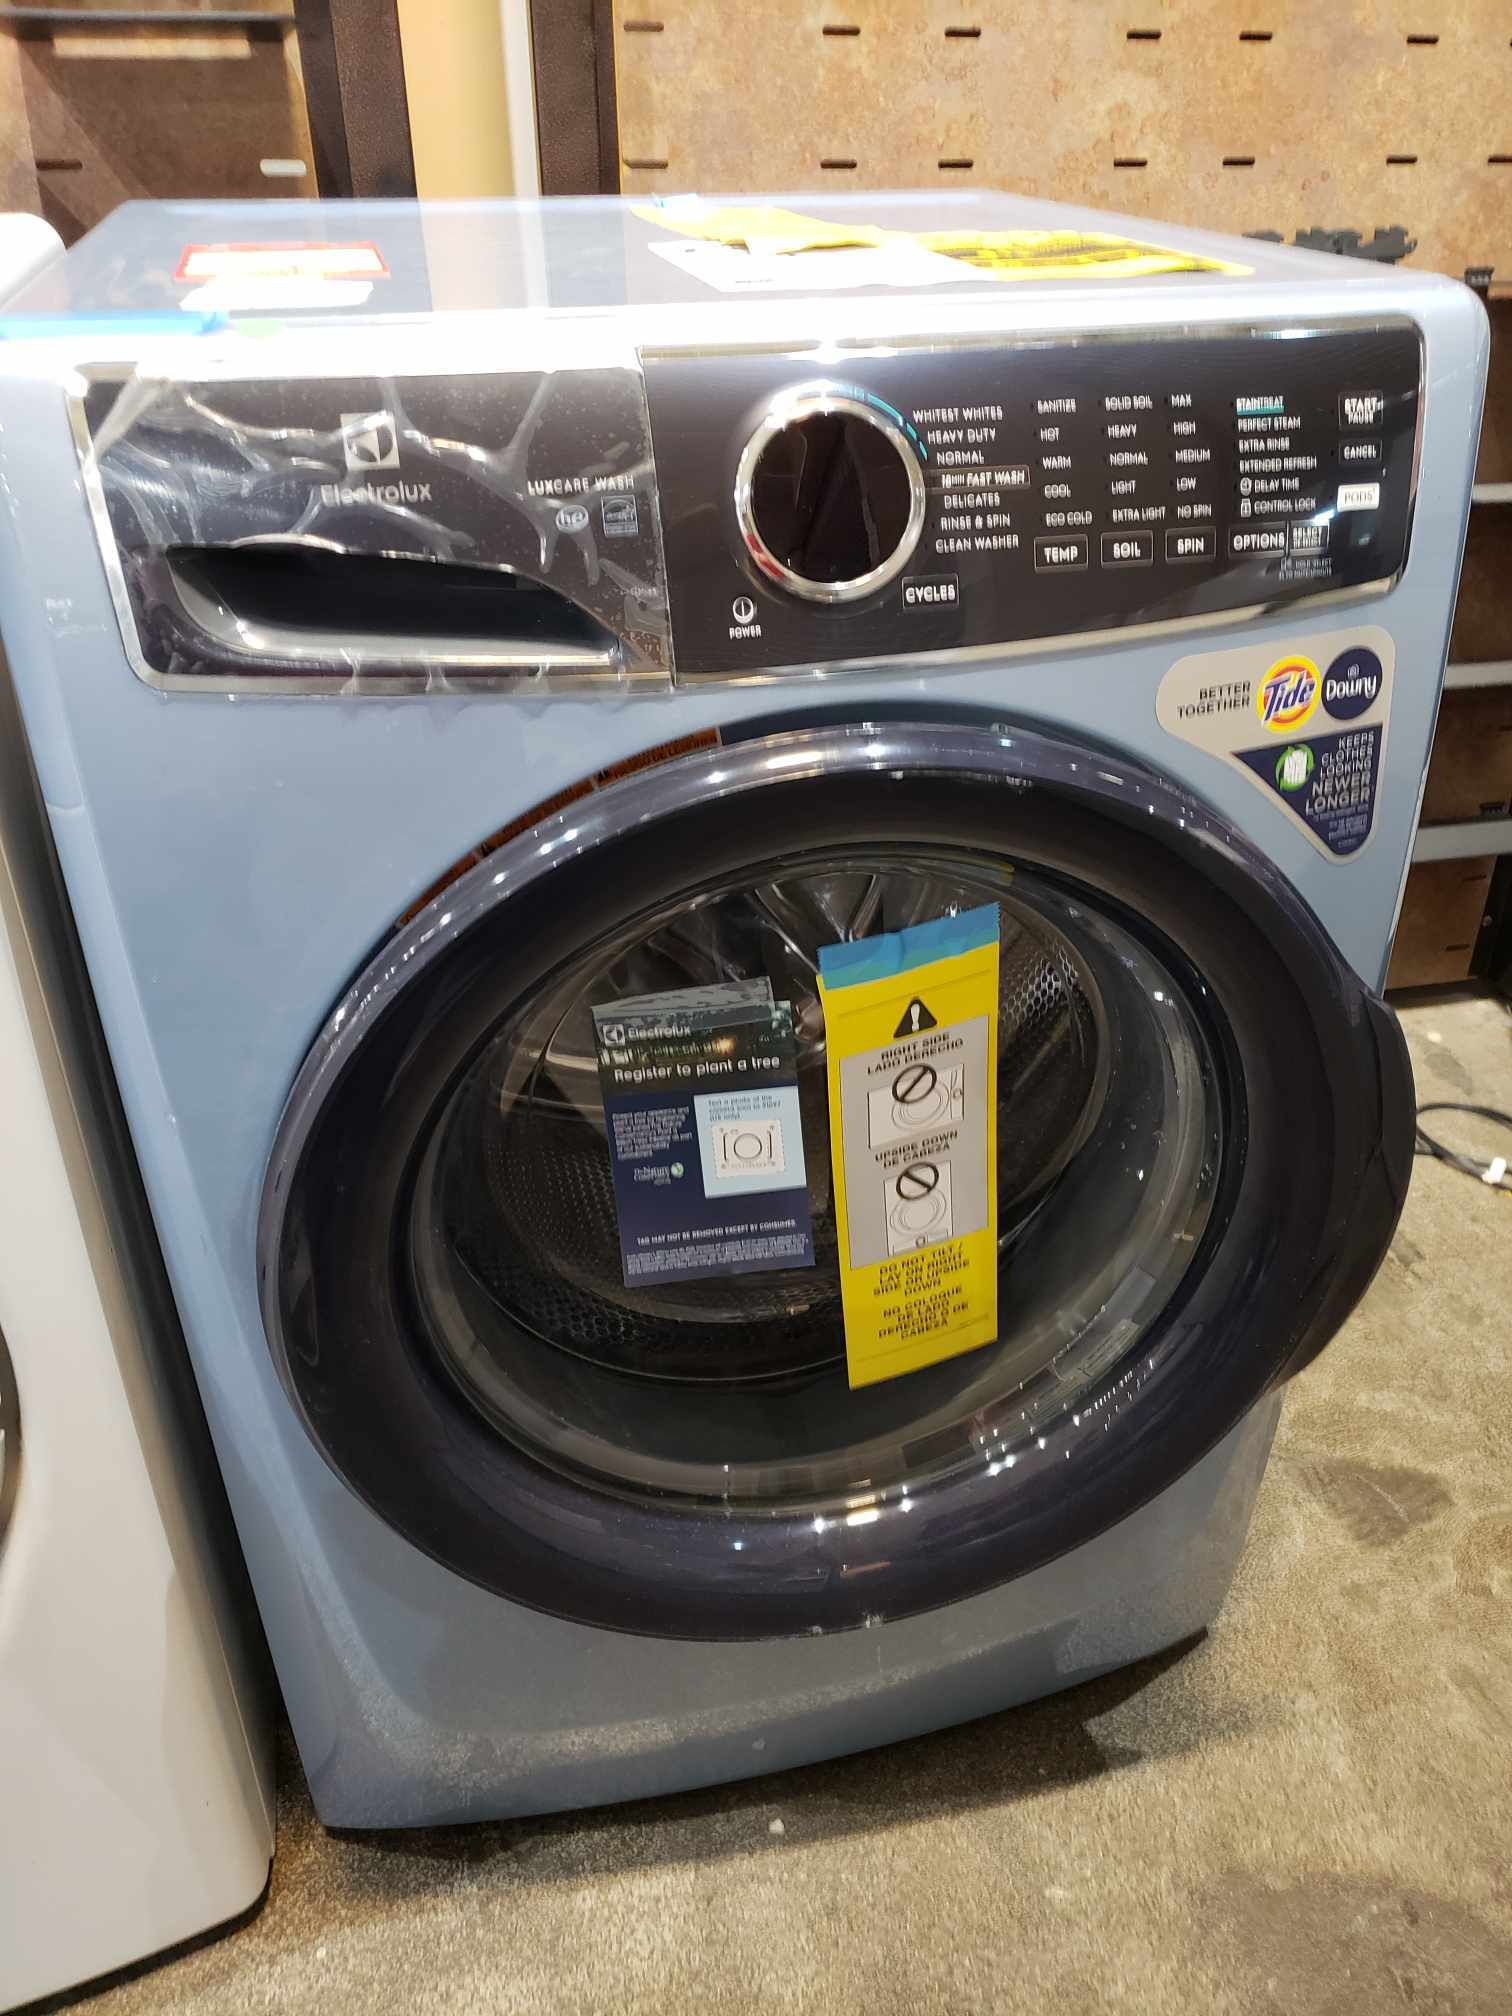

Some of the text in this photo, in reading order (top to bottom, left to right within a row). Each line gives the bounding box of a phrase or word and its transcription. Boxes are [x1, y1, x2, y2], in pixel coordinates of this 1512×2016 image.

[1037, 399, 1077, 414] SANITIZE
[1105, 394, 1153, 412] SOLID SOIL
[1171, 394, 1192, 408] MAX
[1344, 397, 1378, 415] START
[913, 406, 1003, 424] WHITEST WHITES
[1107, 424, 1136, 439] HEAVY
[1173, 421, 1196, 436] HIGH
[1238, 416, 1301, 433] PERFECT STEAM
[927, 427, 996, 445] HEAVY DUTY
[1040, 427, 1060, 442] HOT
[1239, 436, 1290, 453] EXTRA RINSE
[1344, 445, 1376, 460] CANCEL
[936, 449, 985, 466] NORMAL
[1042, 455, 1071, 470] WARM
[1110, 451, 1149, 467] NORMAL
[1175, 448, 1211, 463] MEDIUM
[1239, 456, 1317, 473] EXTENDED REFRESH
[527, 473, 635, 497] LUXCARE WASH
[967, 471, 992, 488] FAST
[995, 469, 1025, 486] WASH
[1111, 480, 1136, 495] LIGHT
[1176, 477, 1197, 491] LOW
[1254, 476, 1300, 494] DELAY TIME
[1044, 483, 1072, 499] COOL
[943, 491, 1001, 510] DELICATES
[1254, 497, 1316, 514] CONTROL LOCK
[560, 509, 584, 526] he
[1045, 510, 1093, 528] ECO COLD
[1112, 506, 1166, 523] EXTRA LIGHT
[1177, 503, 1212, 519] NO SPIN
[940, 513, 1011, 531] RINSE & SPIN
[935, 534, 1019, 554] CLEAN WASHER
[1113, 541, 1141, 559] SOIL
[1177, 537, 1205, 555] SPIN
[1233, 531, 1285, 551] OPTIONS
[1043, 545, 1079, 563] TEMP
[905, 584, 956, 604] CYCLES
[729, 624, 762, 640] POWER
[1199, 680, 1251, 701] BETTER
[1325, 675, 1377, 701] Downy
[1176, 694, 1251, 719] TOGETHER
[1261, 668, 1317, 728] Tide
[1338, 731, 1374, 750] KEEPS
[1321, 743, 1373, 767] CLOTHES
[1320, 758, 1372, 780] LOOKING
[1312, 770, 1371, 799] NEWER
[1305, 786, 1370, 816] LONGER
[627, 1023, 692, 1040] Electrolux
[614, 1056, 781, 1084] Register to plant a tree
